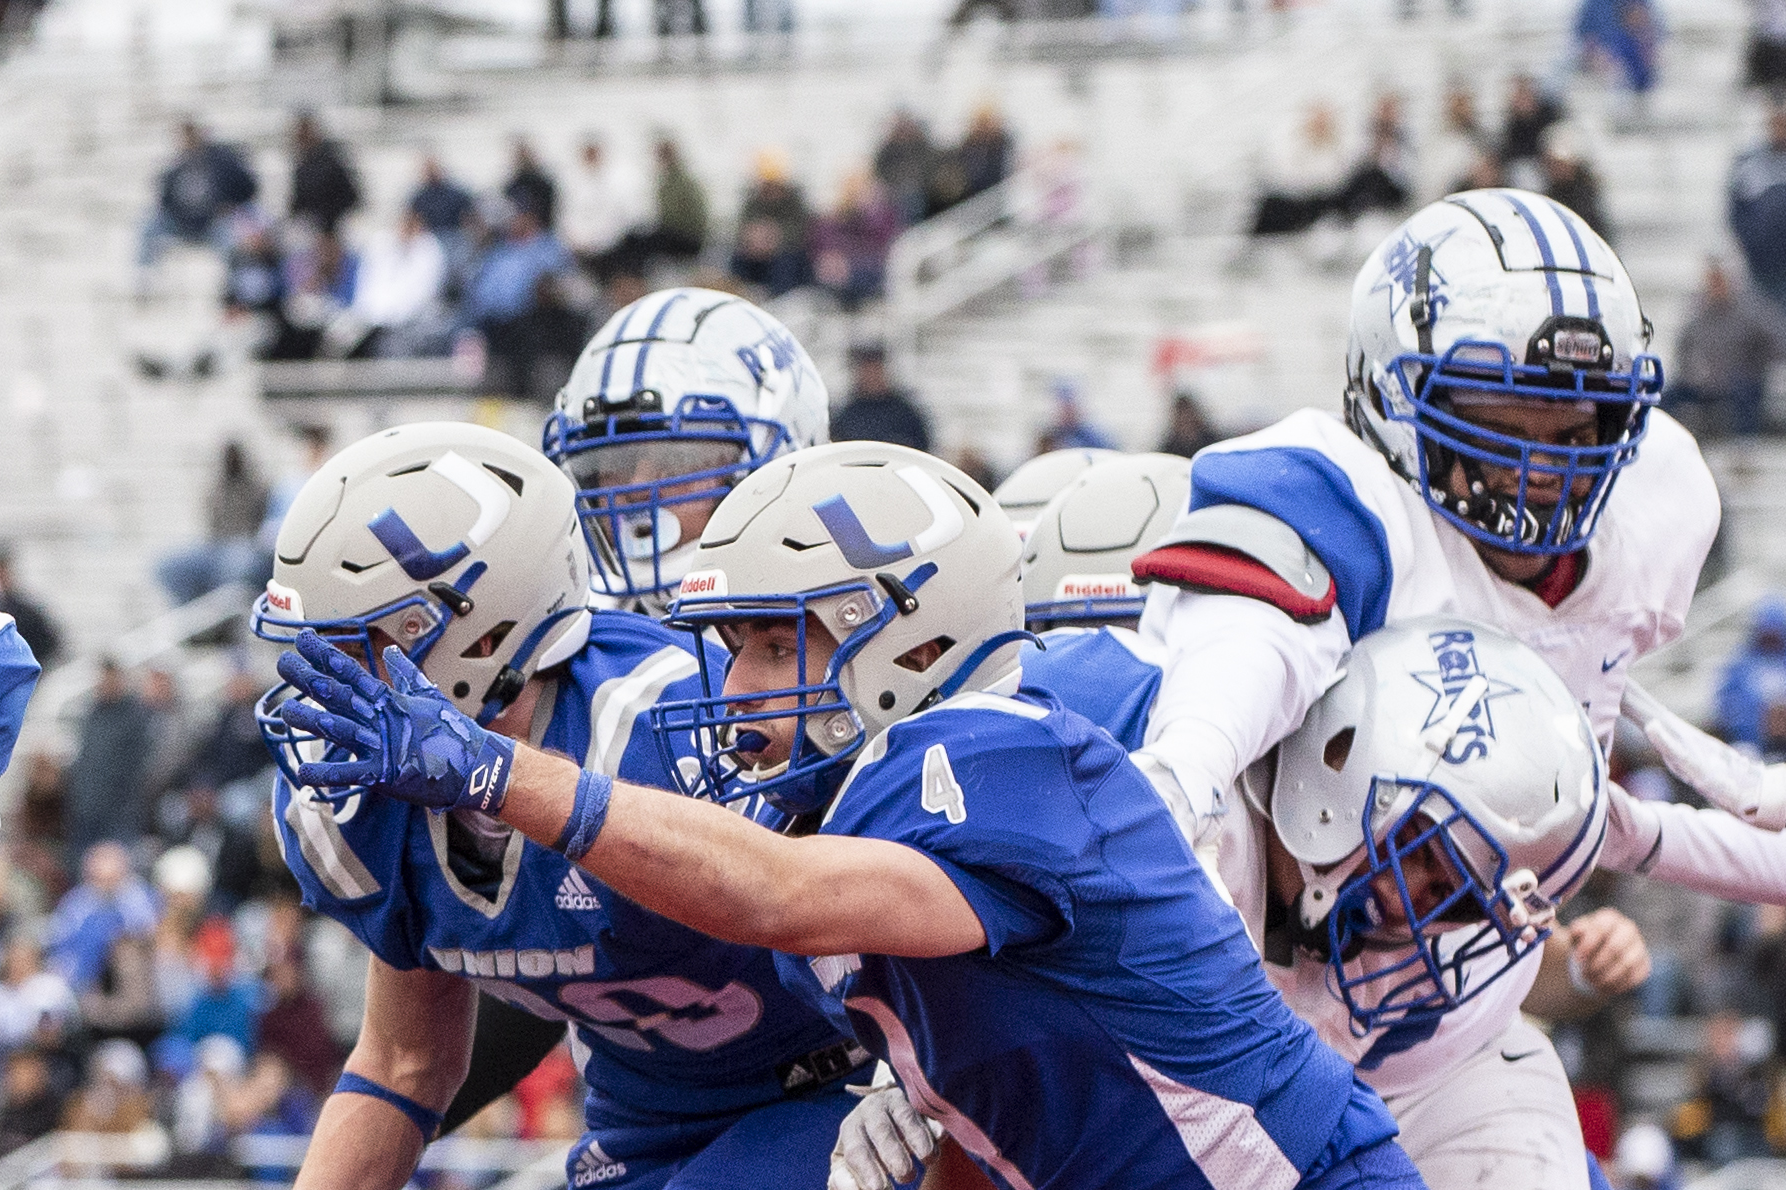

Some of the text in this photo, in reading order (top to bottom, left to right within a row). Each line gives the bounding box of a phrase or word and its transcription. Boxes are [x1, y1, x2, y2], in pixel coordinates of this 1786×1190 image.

[367, 450, 511, 582] U
[812, 466, 964, 570] U
[480, 755, 504, 810] CUTTERS
[921, 743, 967, 824] 4
[555, 893, 602, 910] adidas
[427, 945, 596, 979] UNION
[575, 1162, 627, 1188] adidas
